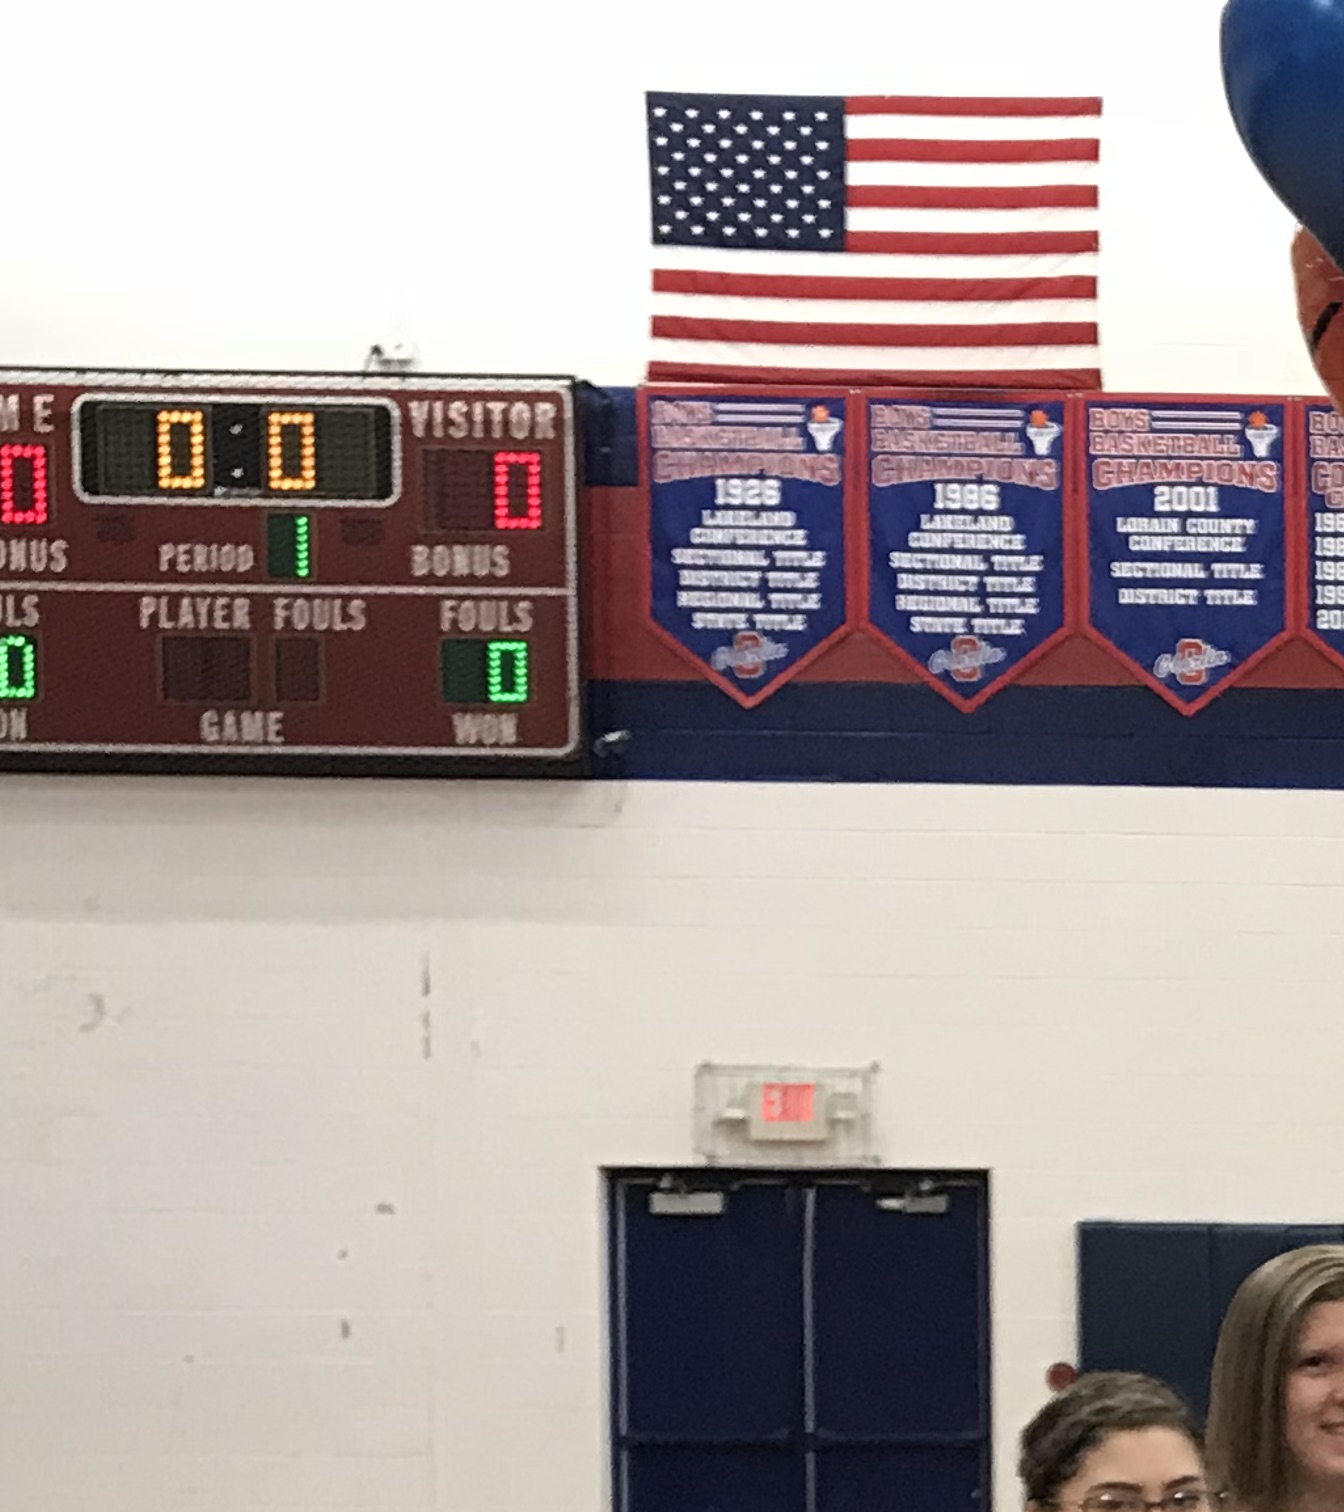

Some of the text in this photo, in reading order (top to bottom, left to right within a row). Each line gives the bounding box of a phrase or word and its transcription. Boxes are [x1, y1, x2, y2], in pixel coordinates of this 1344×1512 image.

[408, 401, 556, 441] VISITOR
[1089, 433, 1244, 457] BASKETBALL
[1092, 458, 1280, 493] CHAMPIONS
[1154, 486, 1220, 512] 2001
[1116, 517, 1258, 534] LORAIN COUNTY
[159, 544, 255, 574] PERIOD
[1128, 536, 1247, 552] CONFERENCE
[411, 545, 511, 578] BONUS
[1110, 562, 1265, 579] SECTIONAL TITLE
[1118, 588, 1258, 606] DISTRICT TITLE
[139, 597, 367, 632] PLAYER FOULS
[440, 600, 534, 633] FOULS
[200, 711, 285, 745] GAME
[452, 713, 519, 745] WON
